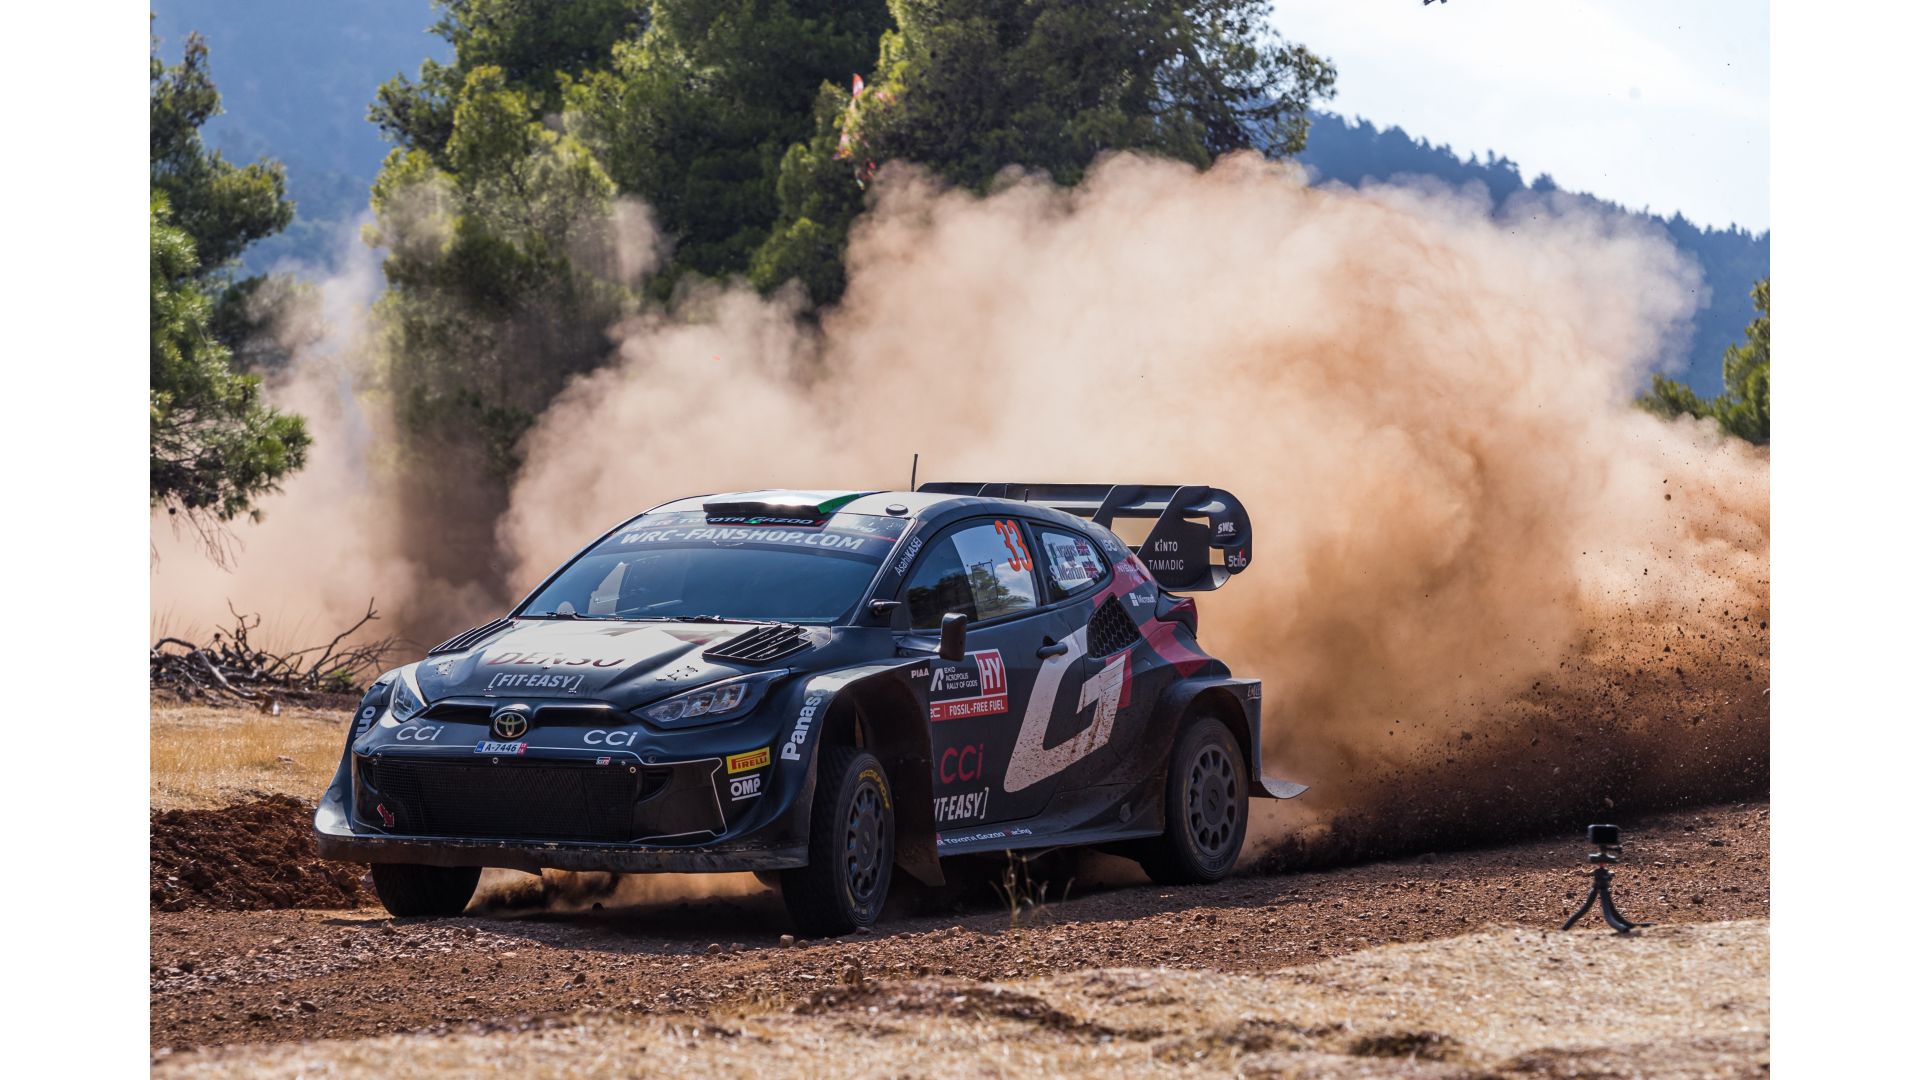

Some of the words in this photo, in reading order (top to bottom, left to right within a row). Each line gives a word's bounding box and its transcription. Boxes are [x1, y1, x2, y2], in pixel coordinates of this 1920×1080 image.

[621, 528, 865, 550] WRC-FANSHOP.COM
[994, 519, 1033, 572] 33
[894, 536, 923, 577] AsahiKASEI
[1148, 559, 1184, 571] TAMADIC
[1228, 550, 1247, 568] Stilo
[911, 667, 930, 679] PIAA
[978, 657, 1001, 690] HY
[946, 682, 959, 690] RALLY
[965, 679, 978, 688] GODS
[949, 701, 989, 717] FOSSIL-FREE
[989, 699, 1005, 711] FUEL
[484, 743, 517, 752] A-7446
[731, 752, 768, 770] PIRELLI
[730, 778, 761, 797] OMP
